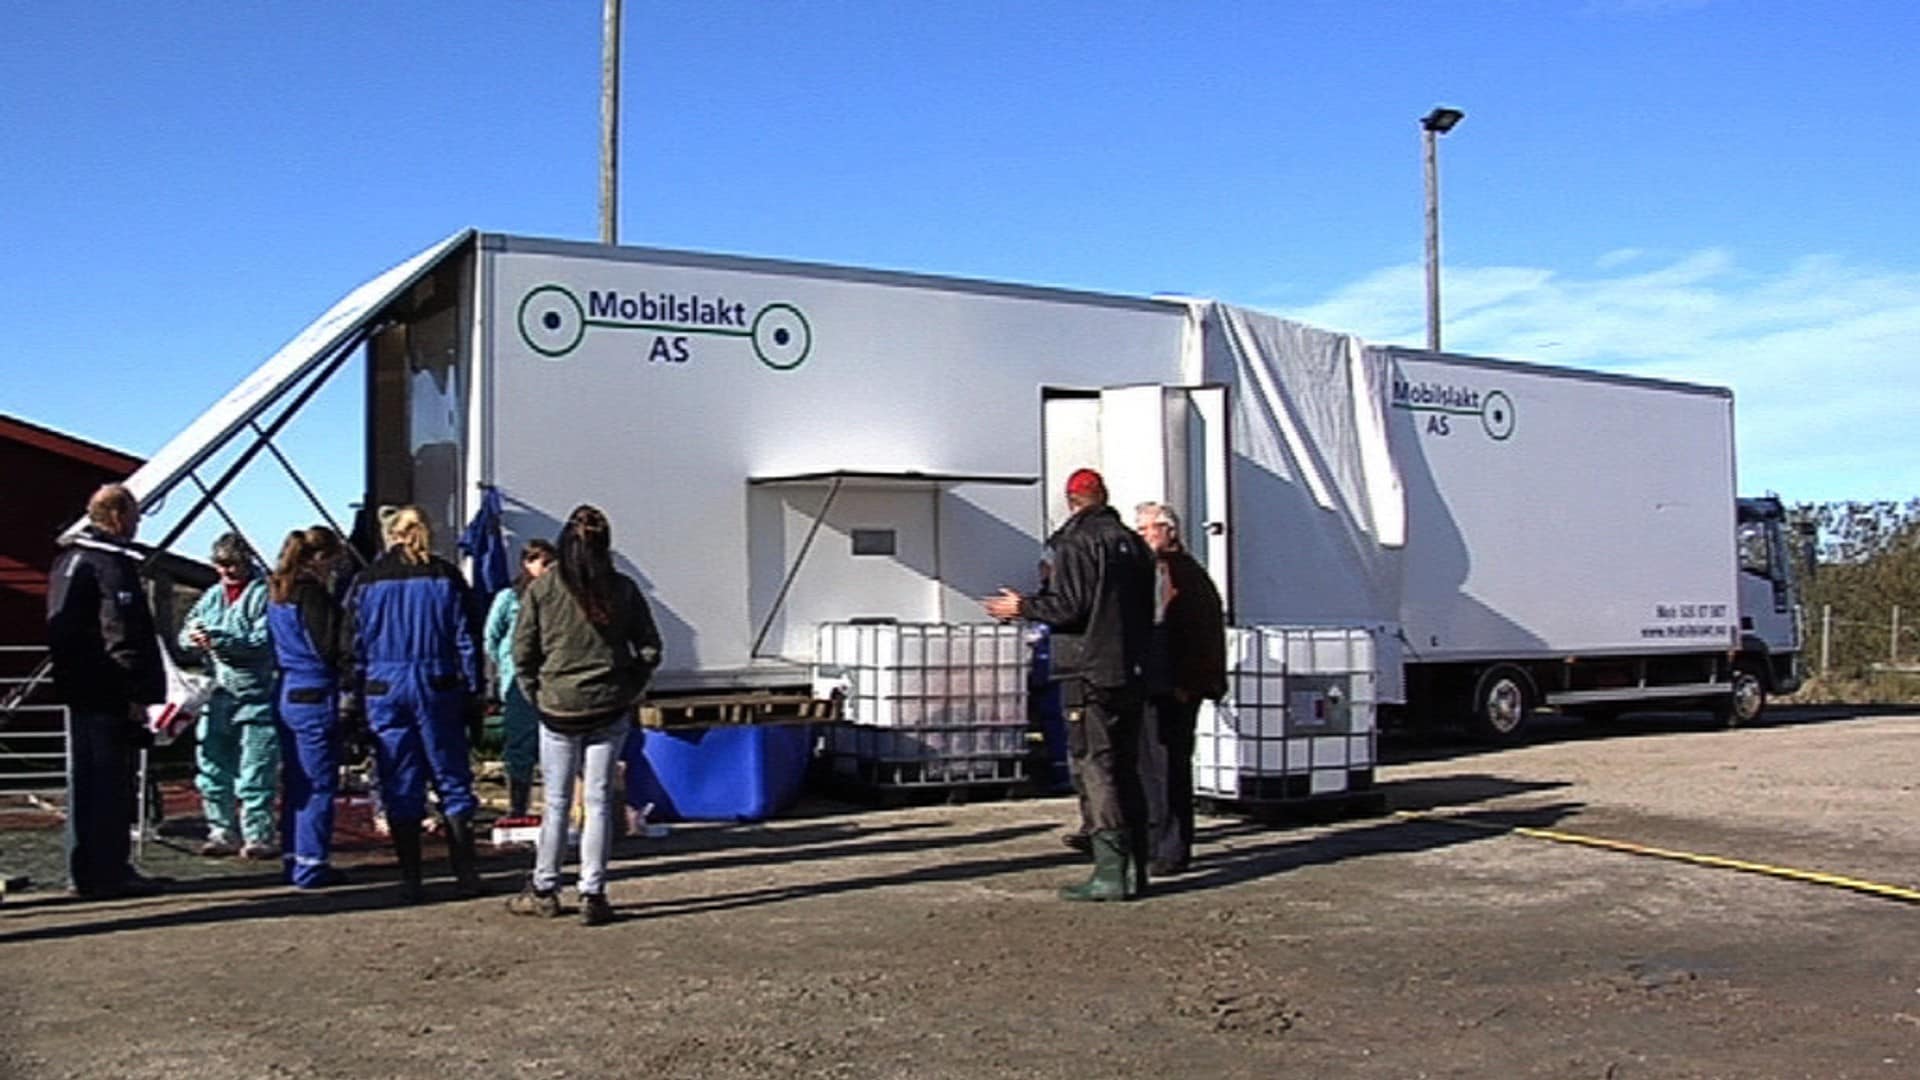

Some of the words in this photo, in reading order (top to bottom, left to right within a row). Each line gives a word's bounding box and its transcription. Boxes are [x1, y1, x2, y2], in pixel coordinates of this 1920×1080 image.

[588, 291, 746, 326] Mobilslakt
[649, 336, 690, 363] AS
[1393, 381, 1479, 408] Mobilslakt
[1427, 415, 1450, 436] AS
